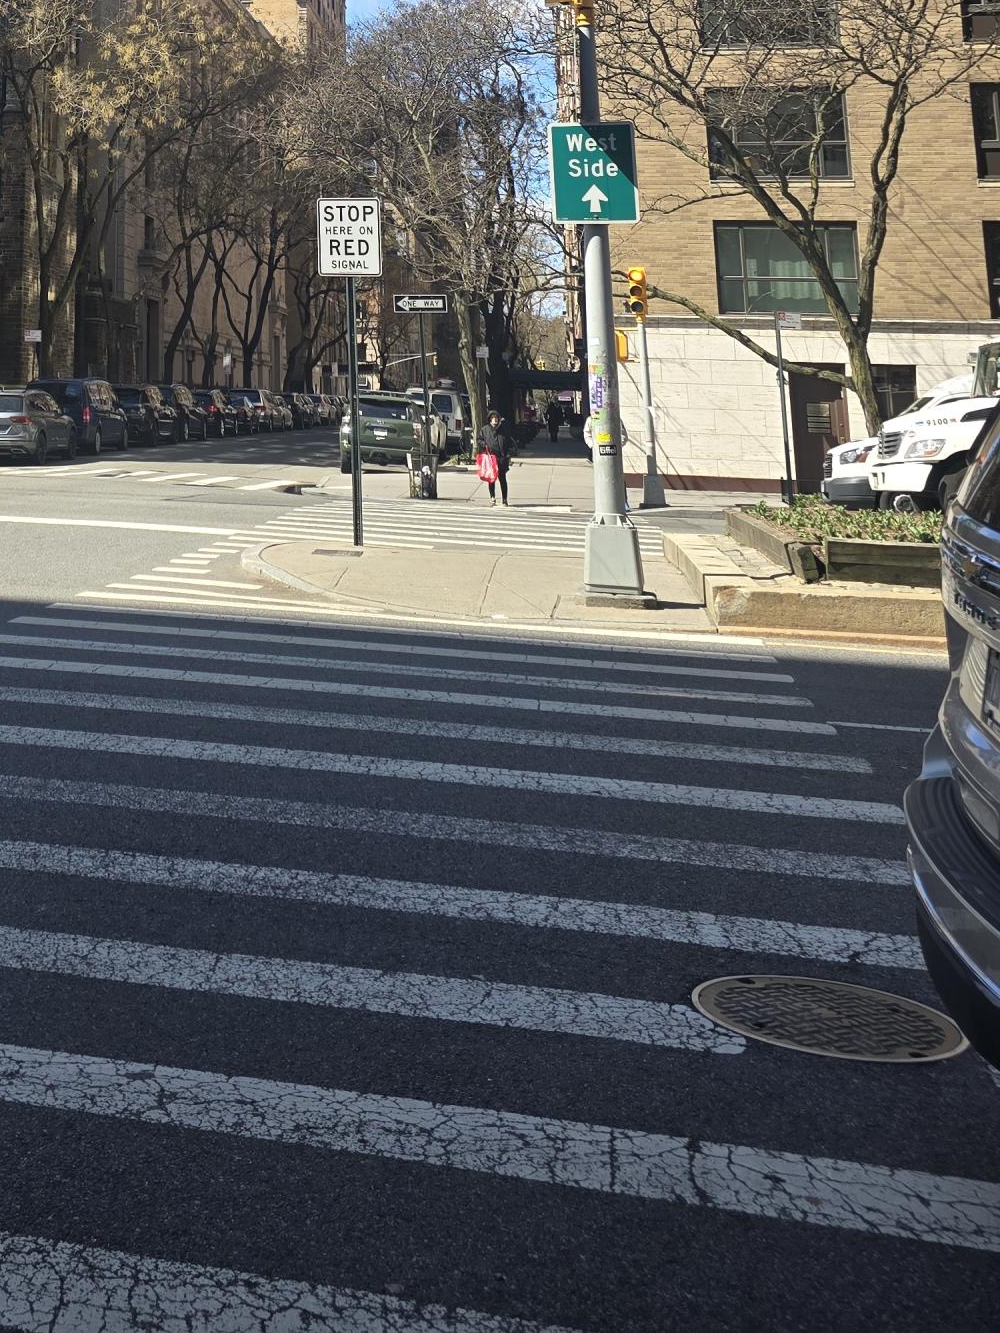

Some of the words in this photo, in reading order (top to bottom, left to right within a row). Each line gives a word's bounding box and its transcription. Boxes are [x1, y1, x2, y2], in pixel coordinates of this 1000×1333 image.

[566, 133, 617, 152] West
[568, 158, 619, 177] Side
[323, 205, 374, 222] STOP
[325, 226, 353, 235] HERE
[359, 226, 373, 235] ON
[329, 239, 369, 256] RED
[331, 260, 369, 269] SIGNAL
[926, 417, 948, 427] 9100
